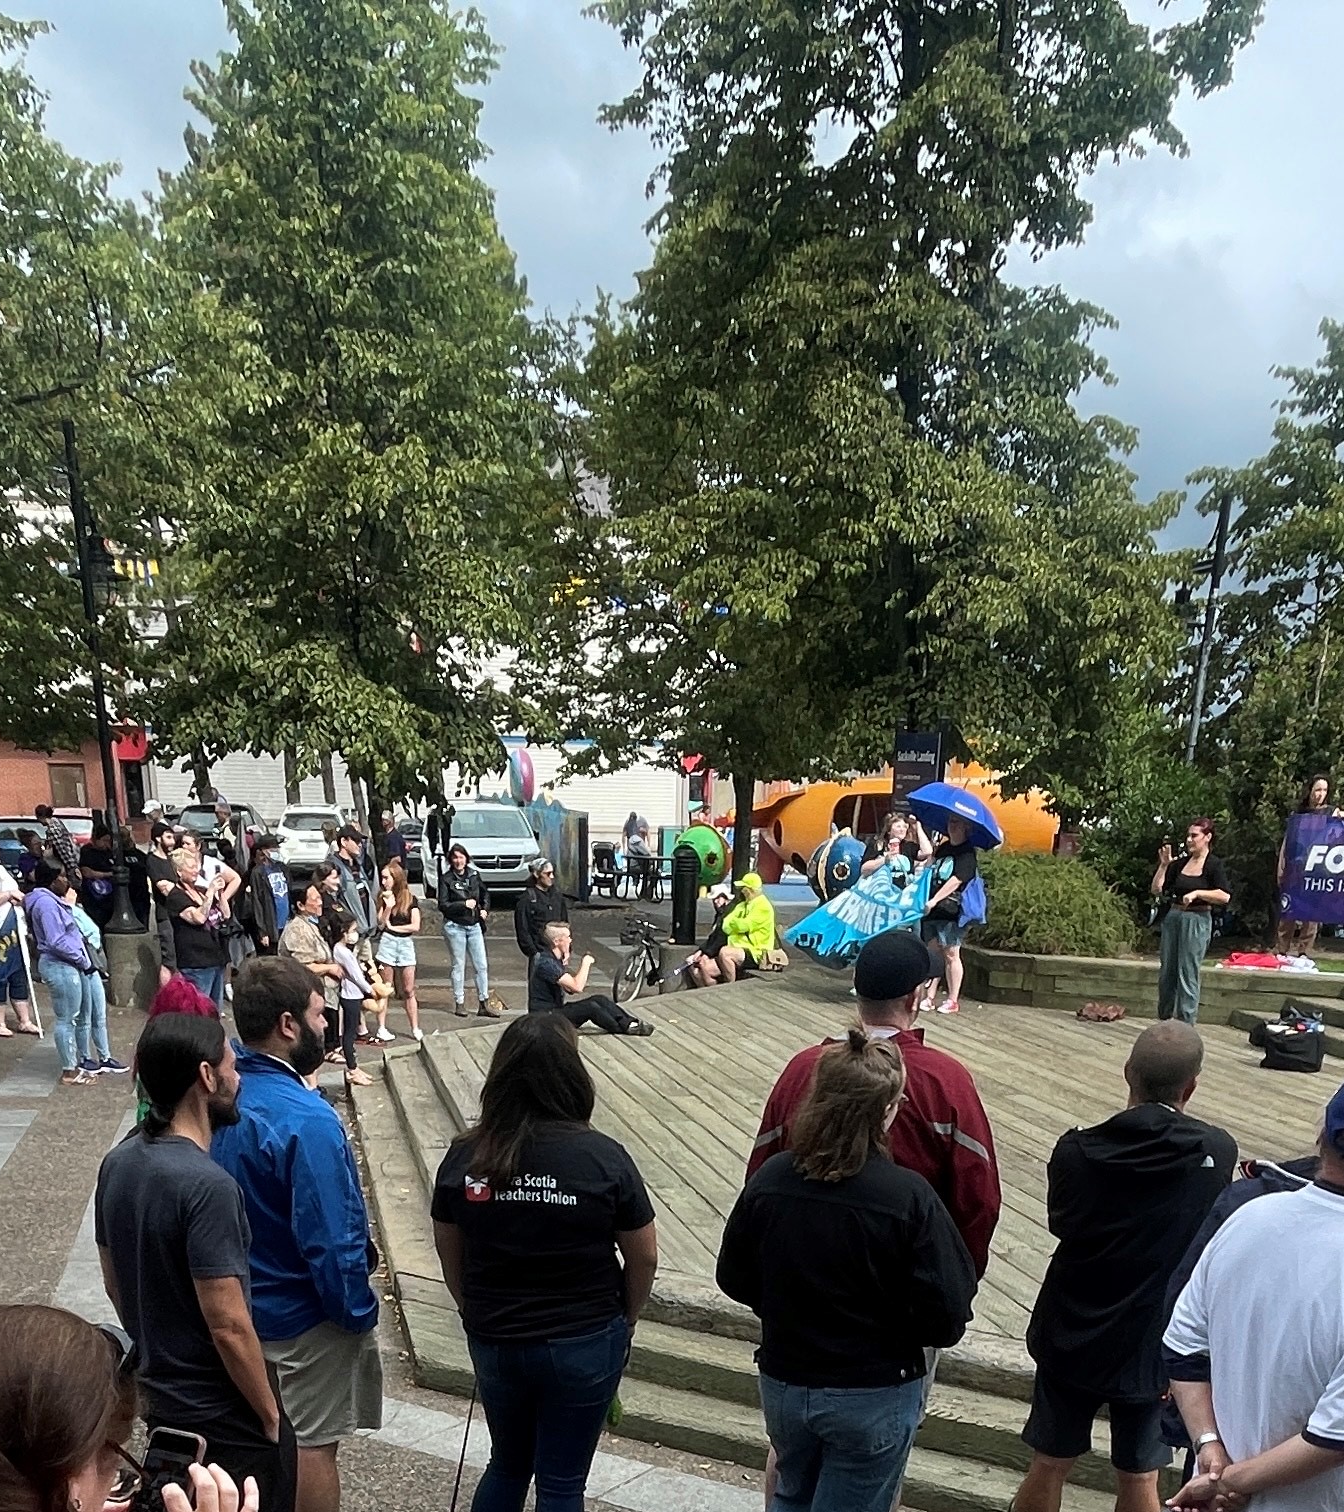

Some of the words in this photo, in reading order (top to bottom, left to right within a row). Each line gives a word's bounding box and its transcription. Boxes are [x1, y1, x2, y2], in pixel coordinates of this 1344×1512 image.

[1304, 877, 1335, 892] THIS
[524, 1173, 557, 1189] Scotia
[542, 1189, 577, 1206] Union
